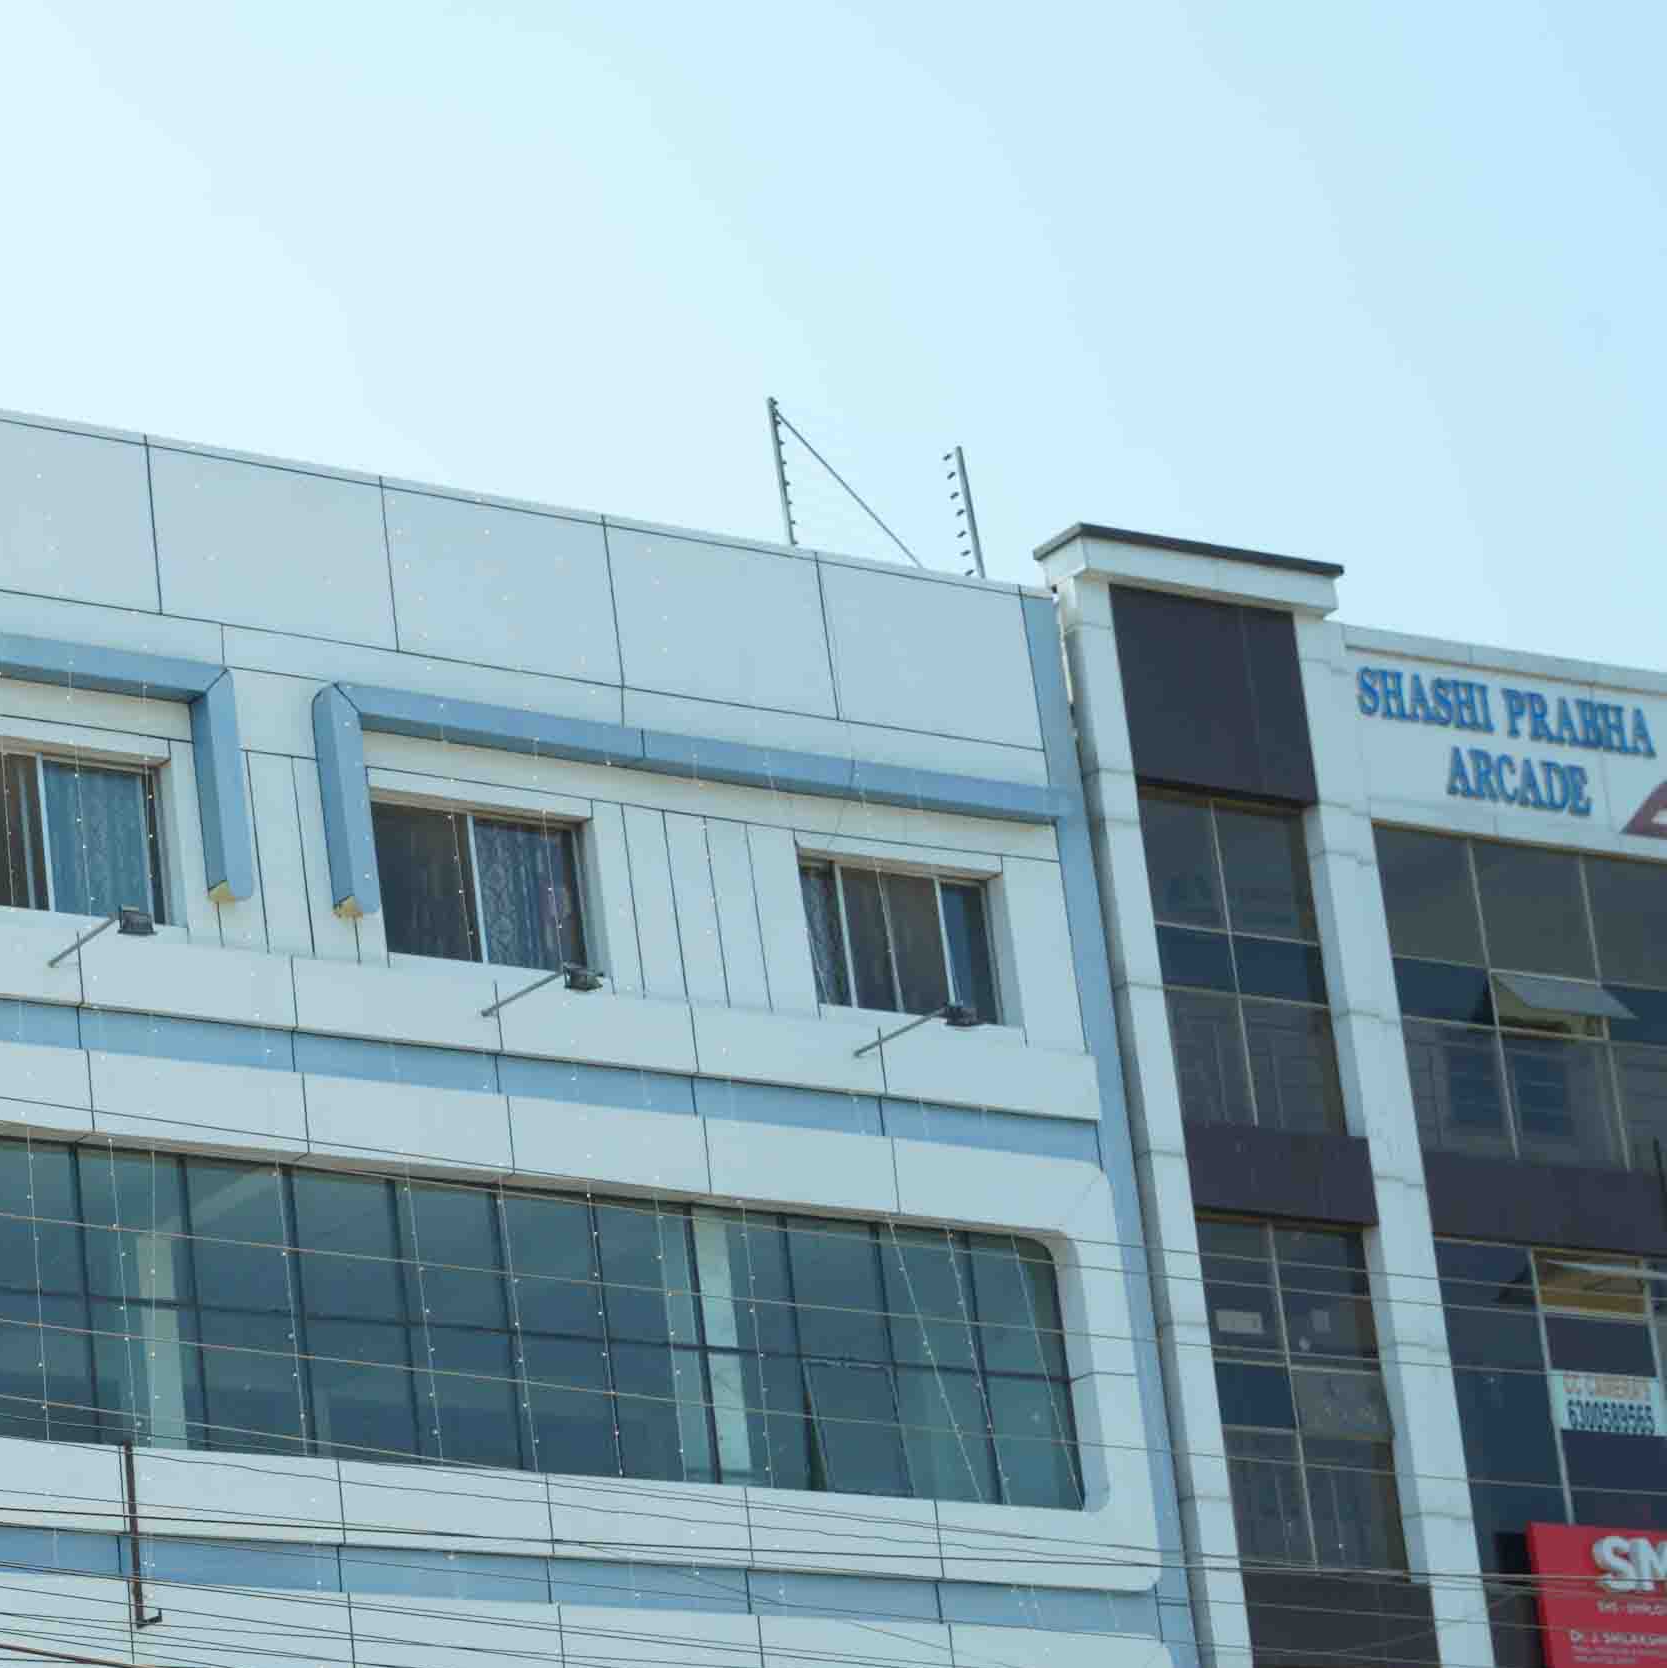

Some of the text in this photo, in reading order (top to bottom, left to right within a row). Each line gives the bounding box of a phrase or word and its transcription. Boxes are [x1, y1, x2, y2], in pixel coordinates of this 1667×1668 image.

[1356, 665, 1657, 759] SHASHI PRABHA
[1446, 746, 1593, 816] ARCADE
